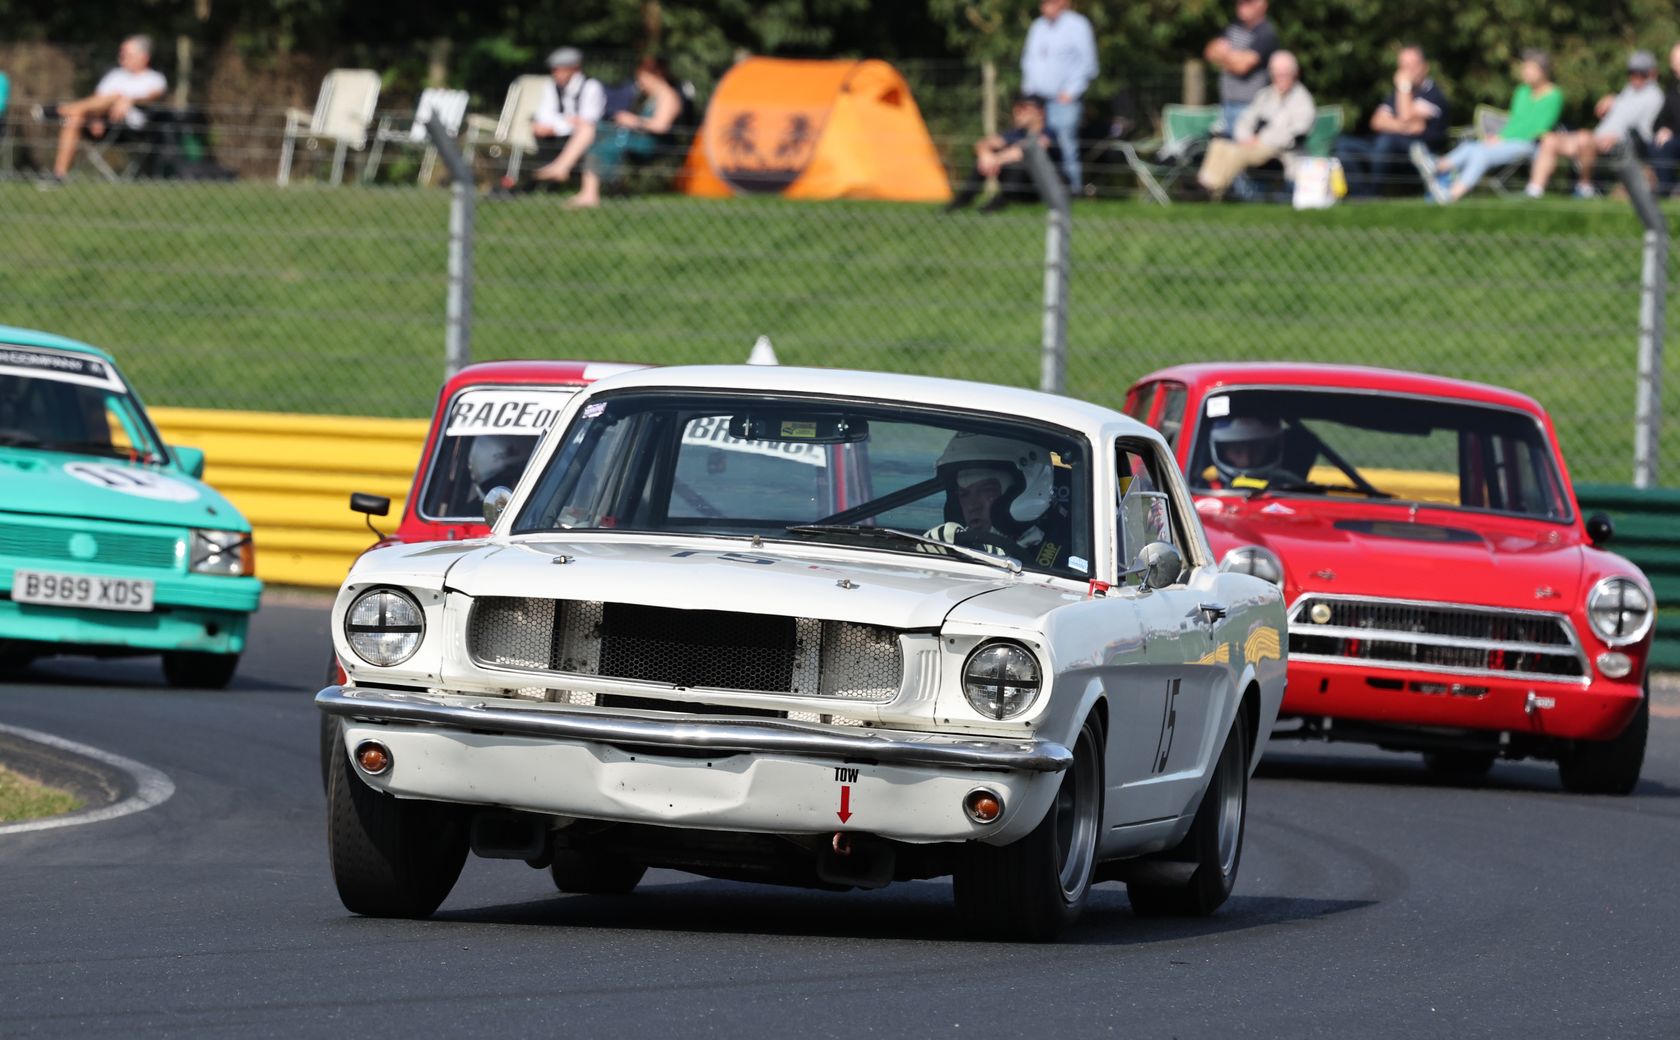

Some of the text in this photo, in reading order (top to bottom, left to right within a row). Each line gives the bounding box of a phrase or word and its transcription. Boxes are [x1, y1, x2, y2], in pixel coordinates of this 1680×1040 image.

[451, 401, 539, 428] RACE
[1038, 542, 1057, 566] OMP
[97, 579, 144, 606] XDS
[1151, 678, 1182, 773] 15
[834, 766, 860, 783] TOW
